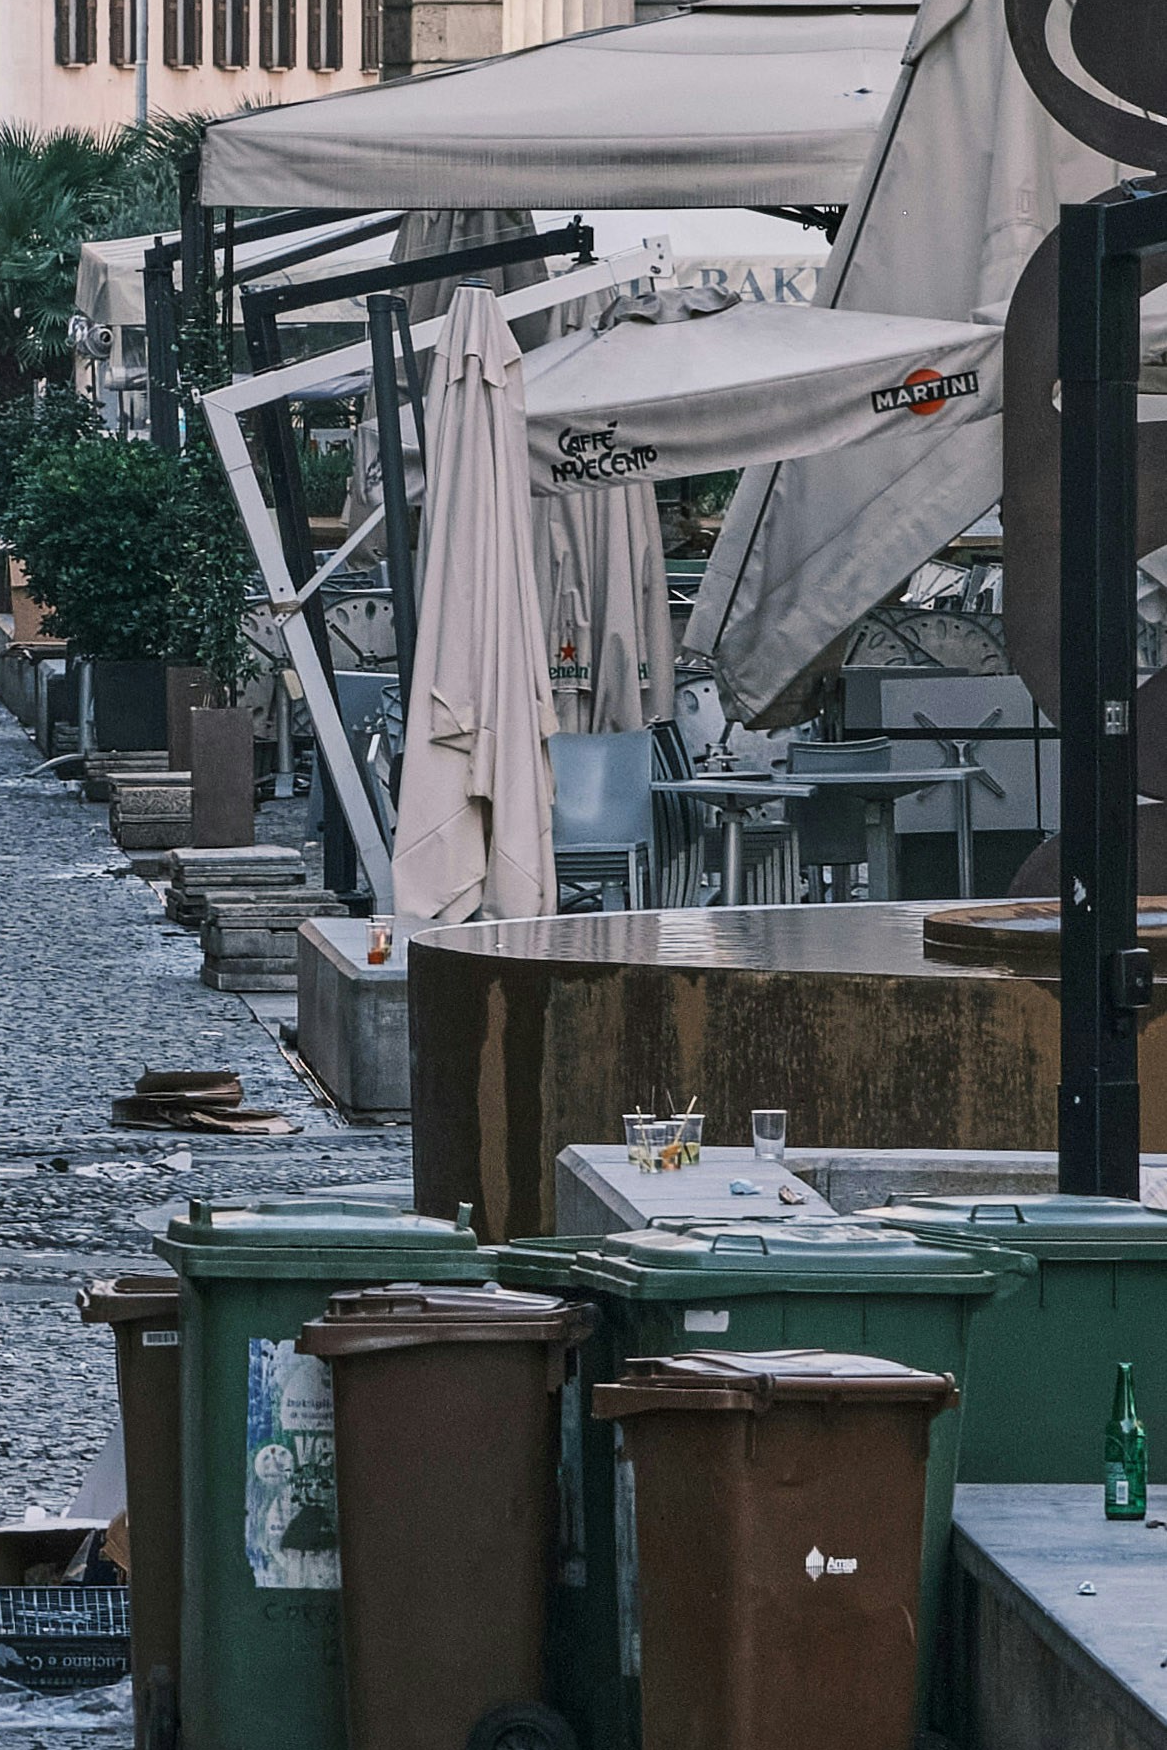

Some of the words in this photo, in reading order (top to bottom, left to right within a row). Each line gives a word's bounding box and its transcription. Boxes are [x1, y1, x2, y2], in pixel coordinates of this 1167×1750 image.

[700, 266, 828, 302] BAK
[875, 373, 976, 410] MARTINI
[25, 1655, 43, 1672] C.
[48, 1656, 58, 1666] e
[62, 1655, 127, 1672] Luciano
